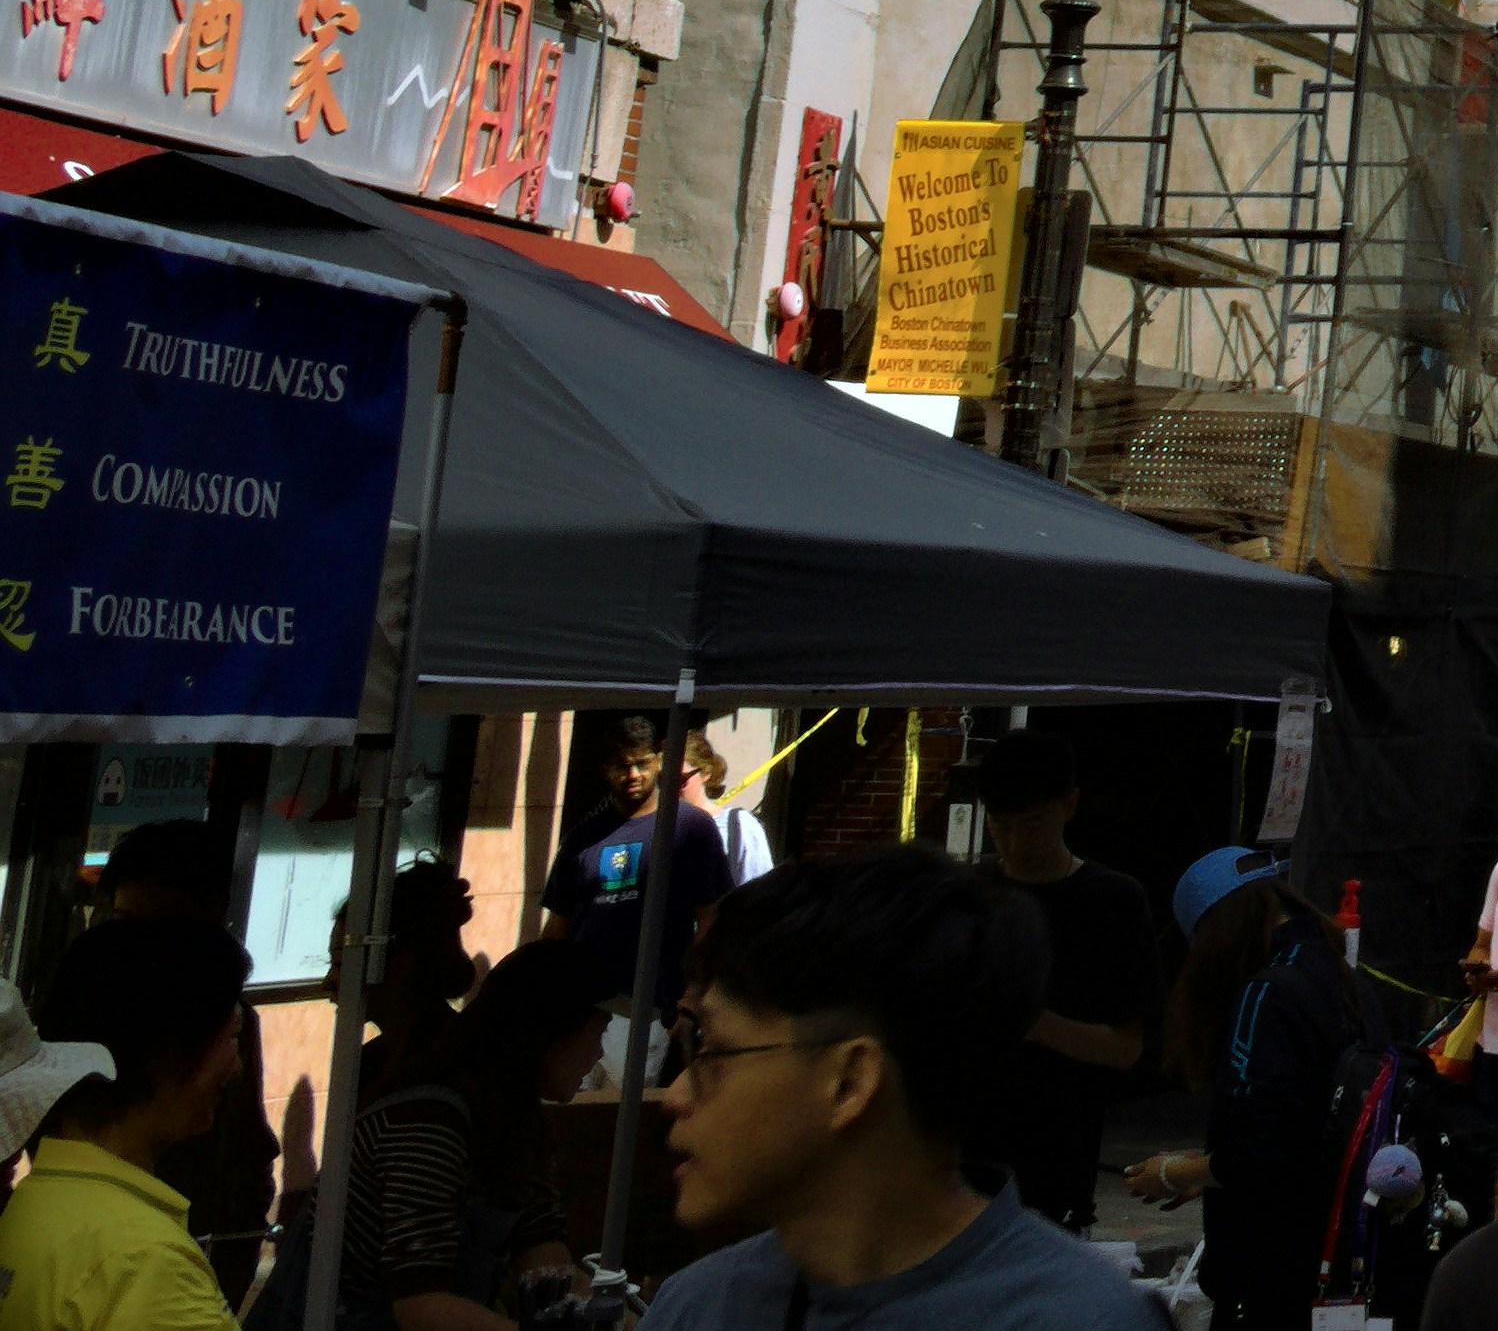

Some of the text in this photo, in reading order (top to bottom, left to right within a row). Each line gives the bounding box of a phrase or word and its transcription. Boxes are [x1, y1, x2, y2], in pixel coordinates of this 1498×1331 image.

[919, 133, 1016, 151] ASIAN CUISINE
[897, 157, 1009, 203] Welcome To
[908, 199, 991, 236] Boston's
[895, 228, 997, 274] Historical
[888, 271, 996, 312] Chinatown
[33, 297, 90, 373] 真
[890, 315, 986, 332] Boston Chinatown
[880, 334, 992, 353] Business Association
[877, 358, 914, 373] MAYOR
[918, 358, 969, 374] MICHELLE
[887, 377, 908, 389] CITY
[911, 377, 926, 389] OF
[6, 435, 65, 509] 善
